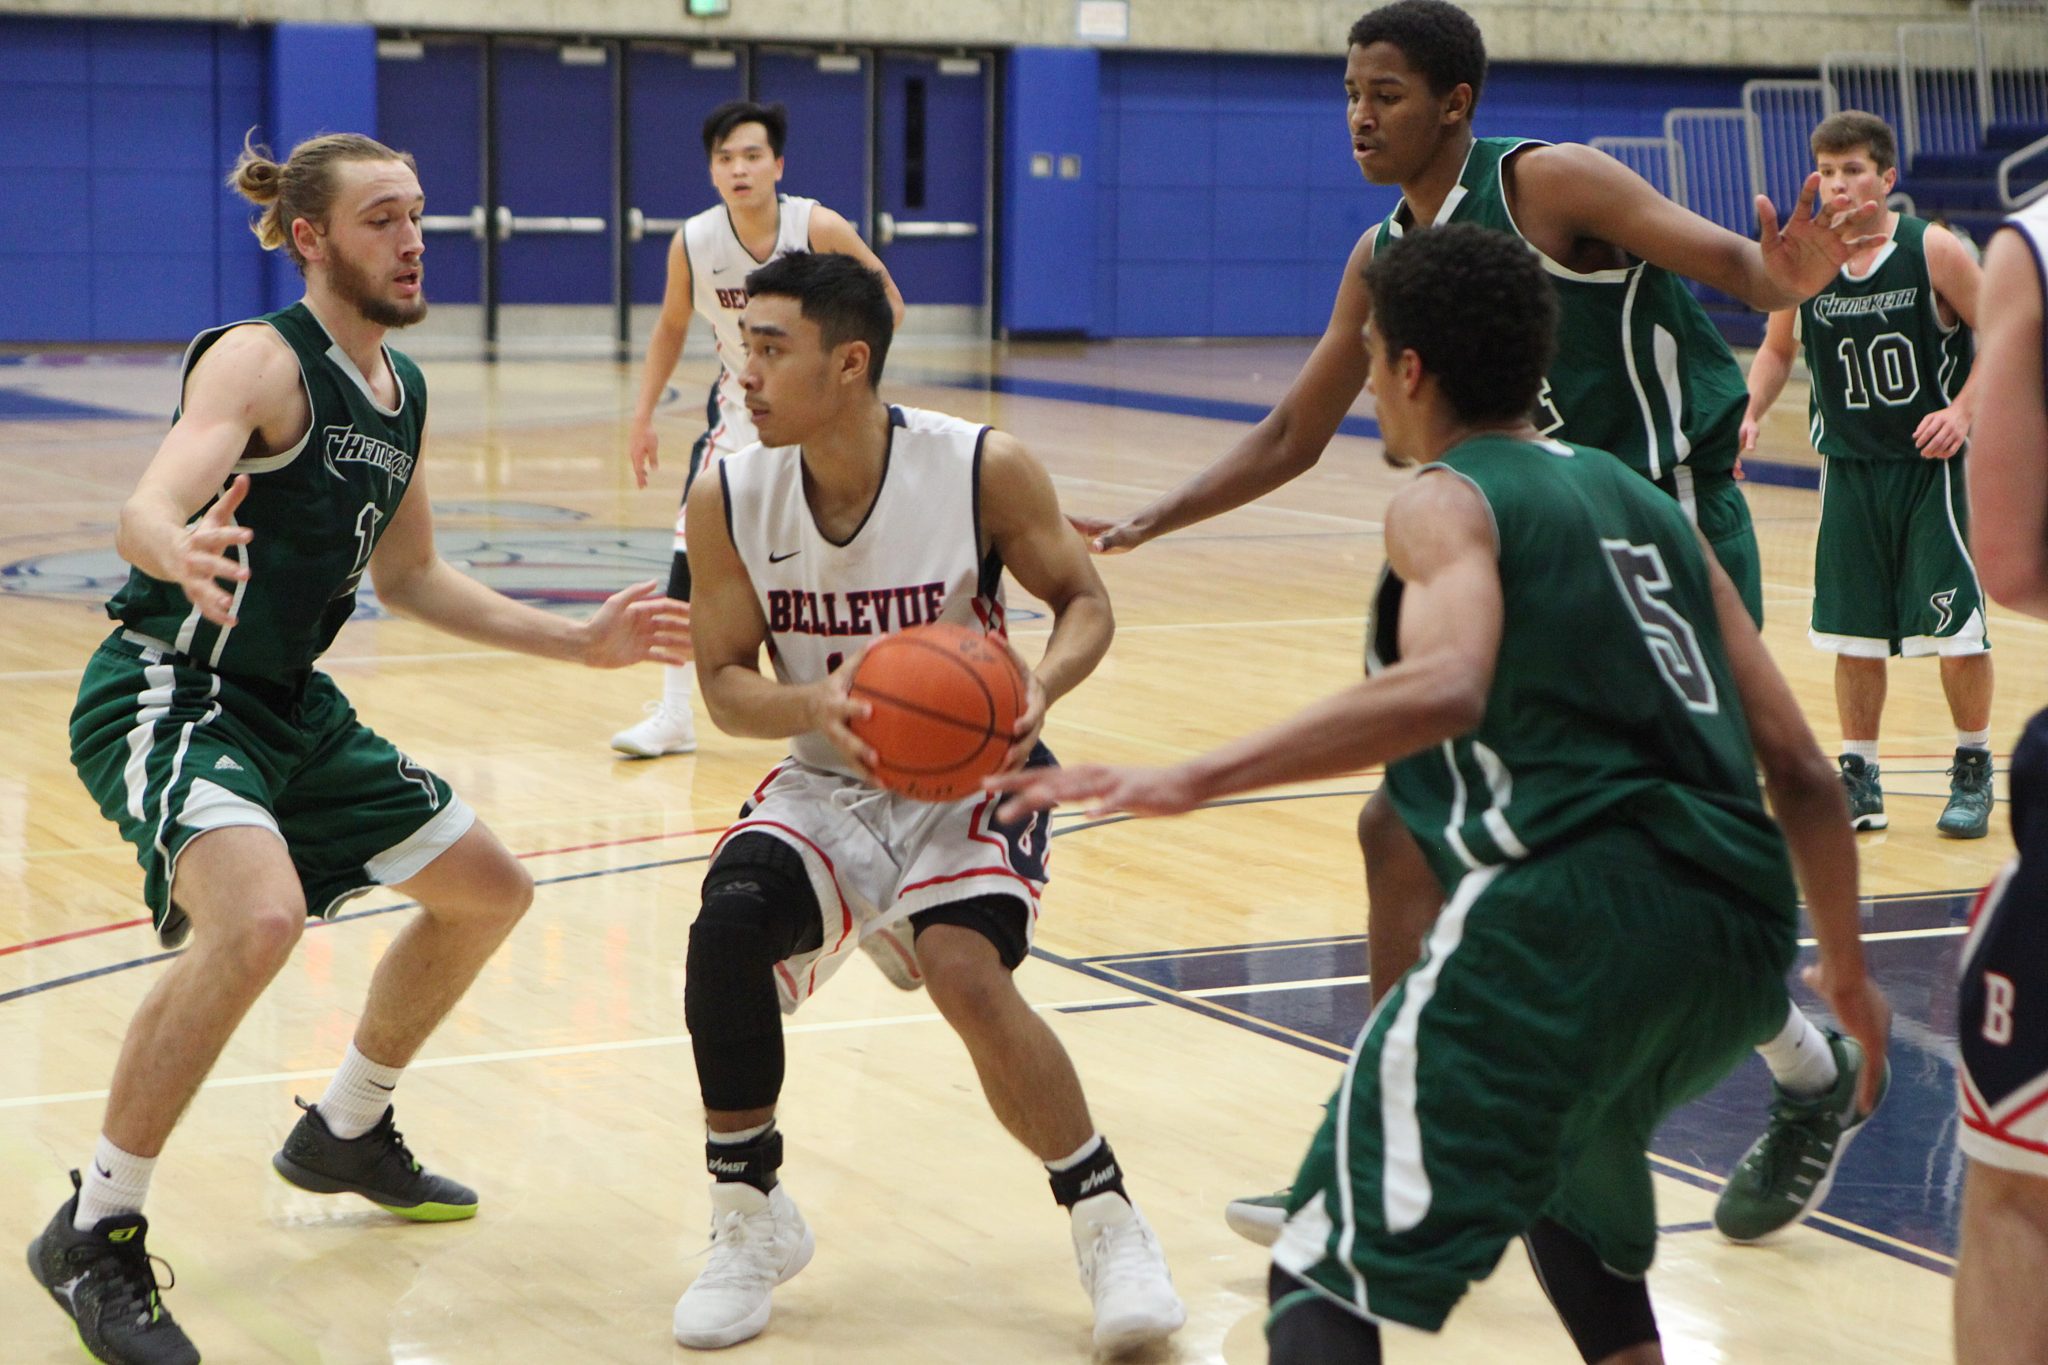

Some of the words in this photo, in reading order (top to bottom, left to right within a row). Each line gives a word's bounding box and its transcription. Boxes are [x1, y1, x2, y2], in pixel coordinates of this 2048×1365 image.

[1814, 288, 1918, 327] CHEMEKETA
[1838, 332, 1920, 409] 10
[768, 581, 945, 636] BELLEVUE
[1600, 538, 1719, 714] 5
[1982, 971, 2015, 1046] B
